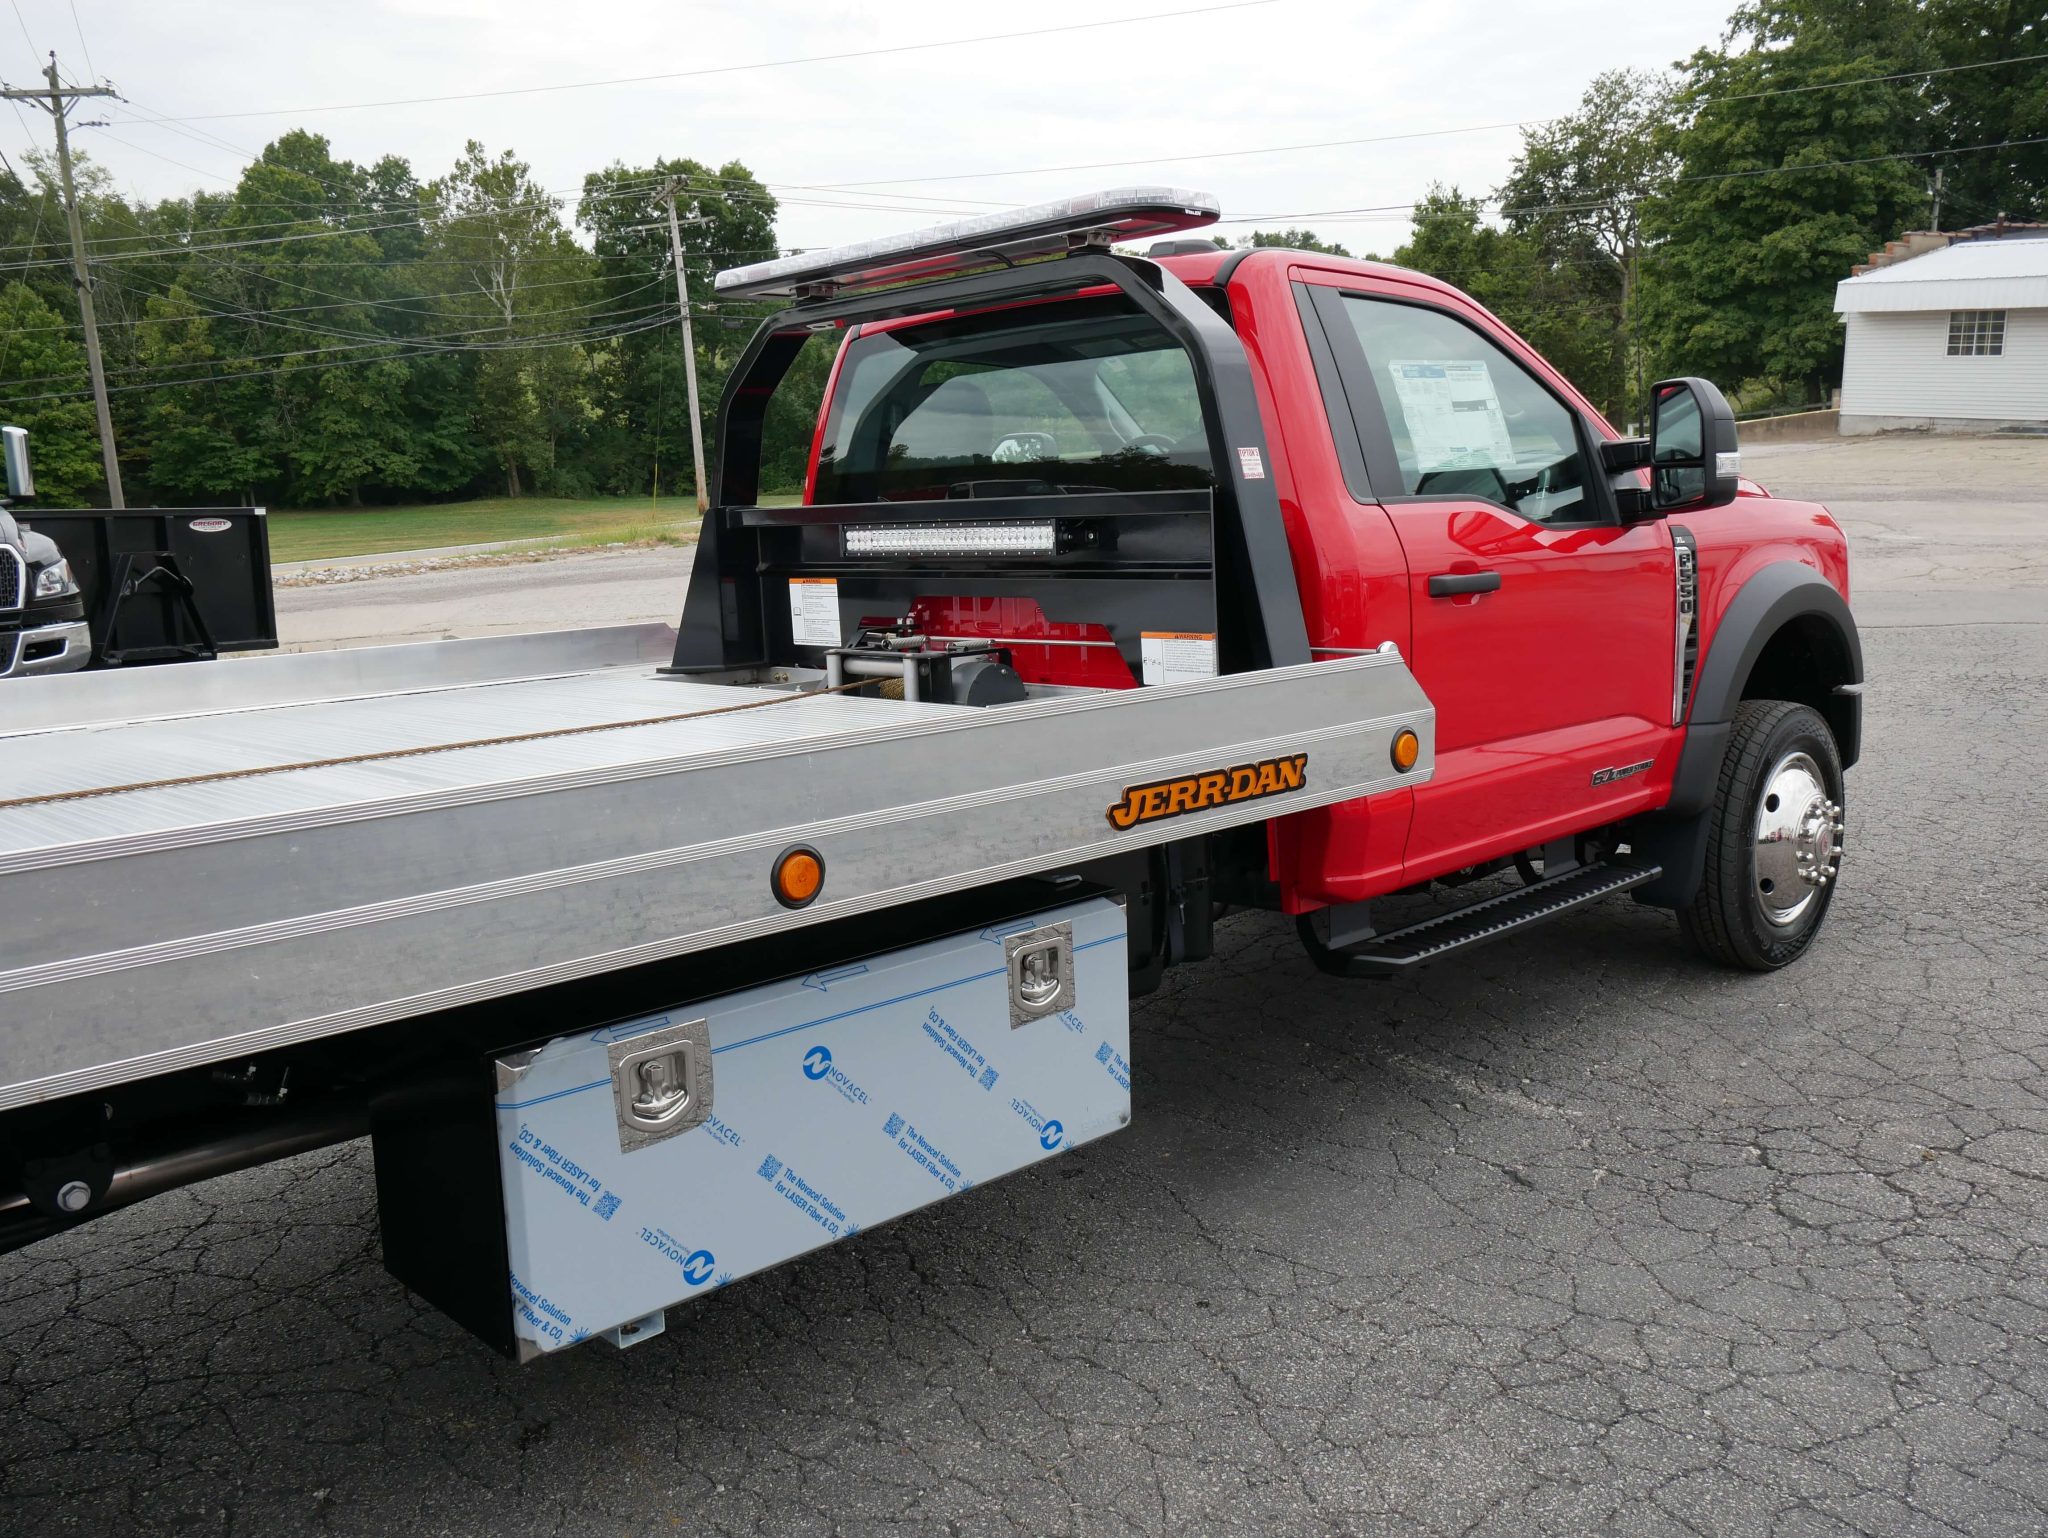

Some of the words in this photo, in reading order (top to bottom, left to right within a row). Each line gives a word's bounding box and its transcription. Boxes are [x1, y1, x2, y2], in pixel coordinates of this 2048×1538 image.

[922, 1022, 946, 1048] Solution
[944, 1024, 959, 1042] Fiber
[944, 1044, 968, 1068] Novacel
[957, 1037, 977, 1059] LASER
[976, 1054, 986, 1067] for
[966, 1064, 978, 1078] The
[1106, 1063, 1116, 1076] for
[828, 1066, 868, 1105] NOVACEL
[1011, 1098, 1043, 1132] NOVACEL
[706, 1113, 740, 1147] OVACEL
[509, 1142, 545, 1173] Solution
[533, 1138, 542, 1150] &
[542, 1143, 564, 1164] Fiber
[906, 1125, 918, 1140] The
[916, 1134, 941, 1160] Novacel
[938, 1154, 962, 1178] Solution
[561, 1158, 590, 1184] LASER
[898, 1137, 908, 1151] for
[906, 1145, 928, 1167] LASER
[926, 1160, 942, 1178] Fiber
[940, 1173, 946, 1183] &
[542, 1167, 577, 1196] Novacel
[588, 1178, 602, 1193] for
[783, 1167, 797, 1184] The
[796, 1178, 822, 1202] Novacel
[820, 1197, 846, 1222] Solution
[576, 1189, 592, 1206] The
[774, 1180, 786, 1194] for
[784, 1188, 808, 1210] LASER
[806, 1204, 824, 1222] Fiber
[821, 1217, 829, 1228] &
[640, 1227, 686, 1266] NOVACEL
[518, 1304, 542, 1327] Fiber
[541, 1321, 550, 1332] &
[538, 1298, 572, 1326] Solution
